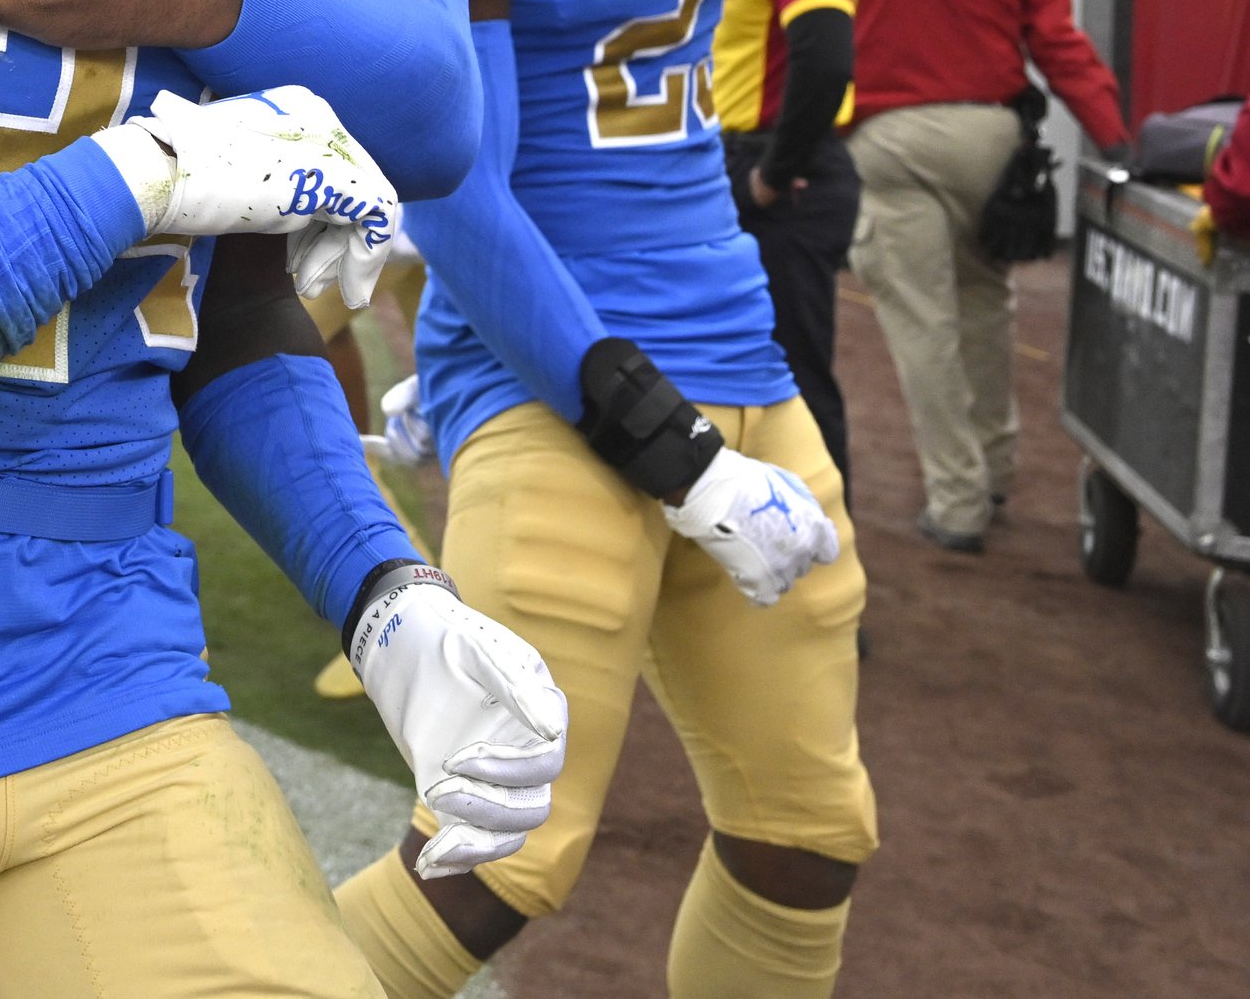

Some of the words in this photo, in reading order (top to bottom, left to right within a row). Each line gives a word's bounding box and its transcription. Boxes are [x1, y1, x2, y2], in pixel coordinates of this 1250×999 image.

[382, 584, 408, 609] NOT
[371, 609, 380, 619] A
[354, 622, 373, 664] PIECE
